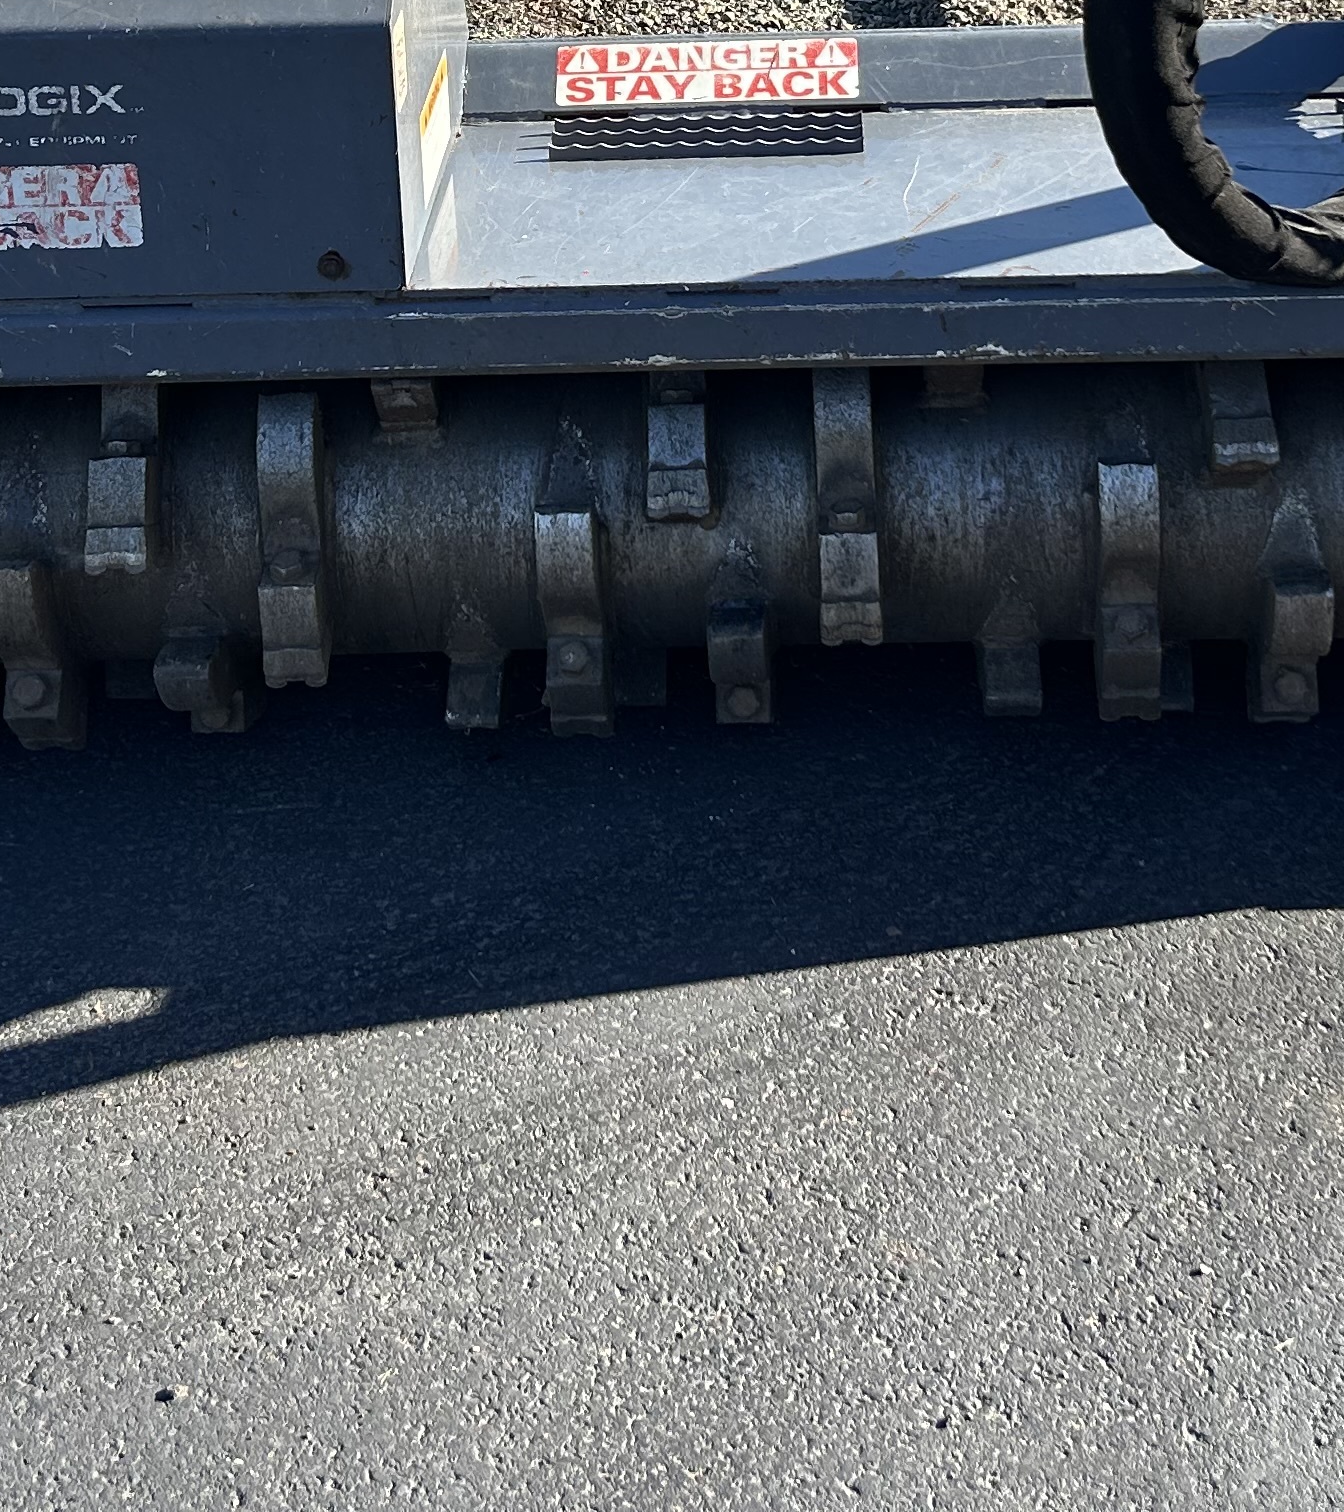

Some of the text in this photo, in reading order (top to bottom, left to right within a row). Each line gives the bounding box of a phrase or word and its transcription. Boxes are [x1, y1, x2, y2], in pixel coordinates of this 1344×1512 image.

[607, 42, 807, 71] DANGER
[565, 70, 850, 103] STAY BACK
